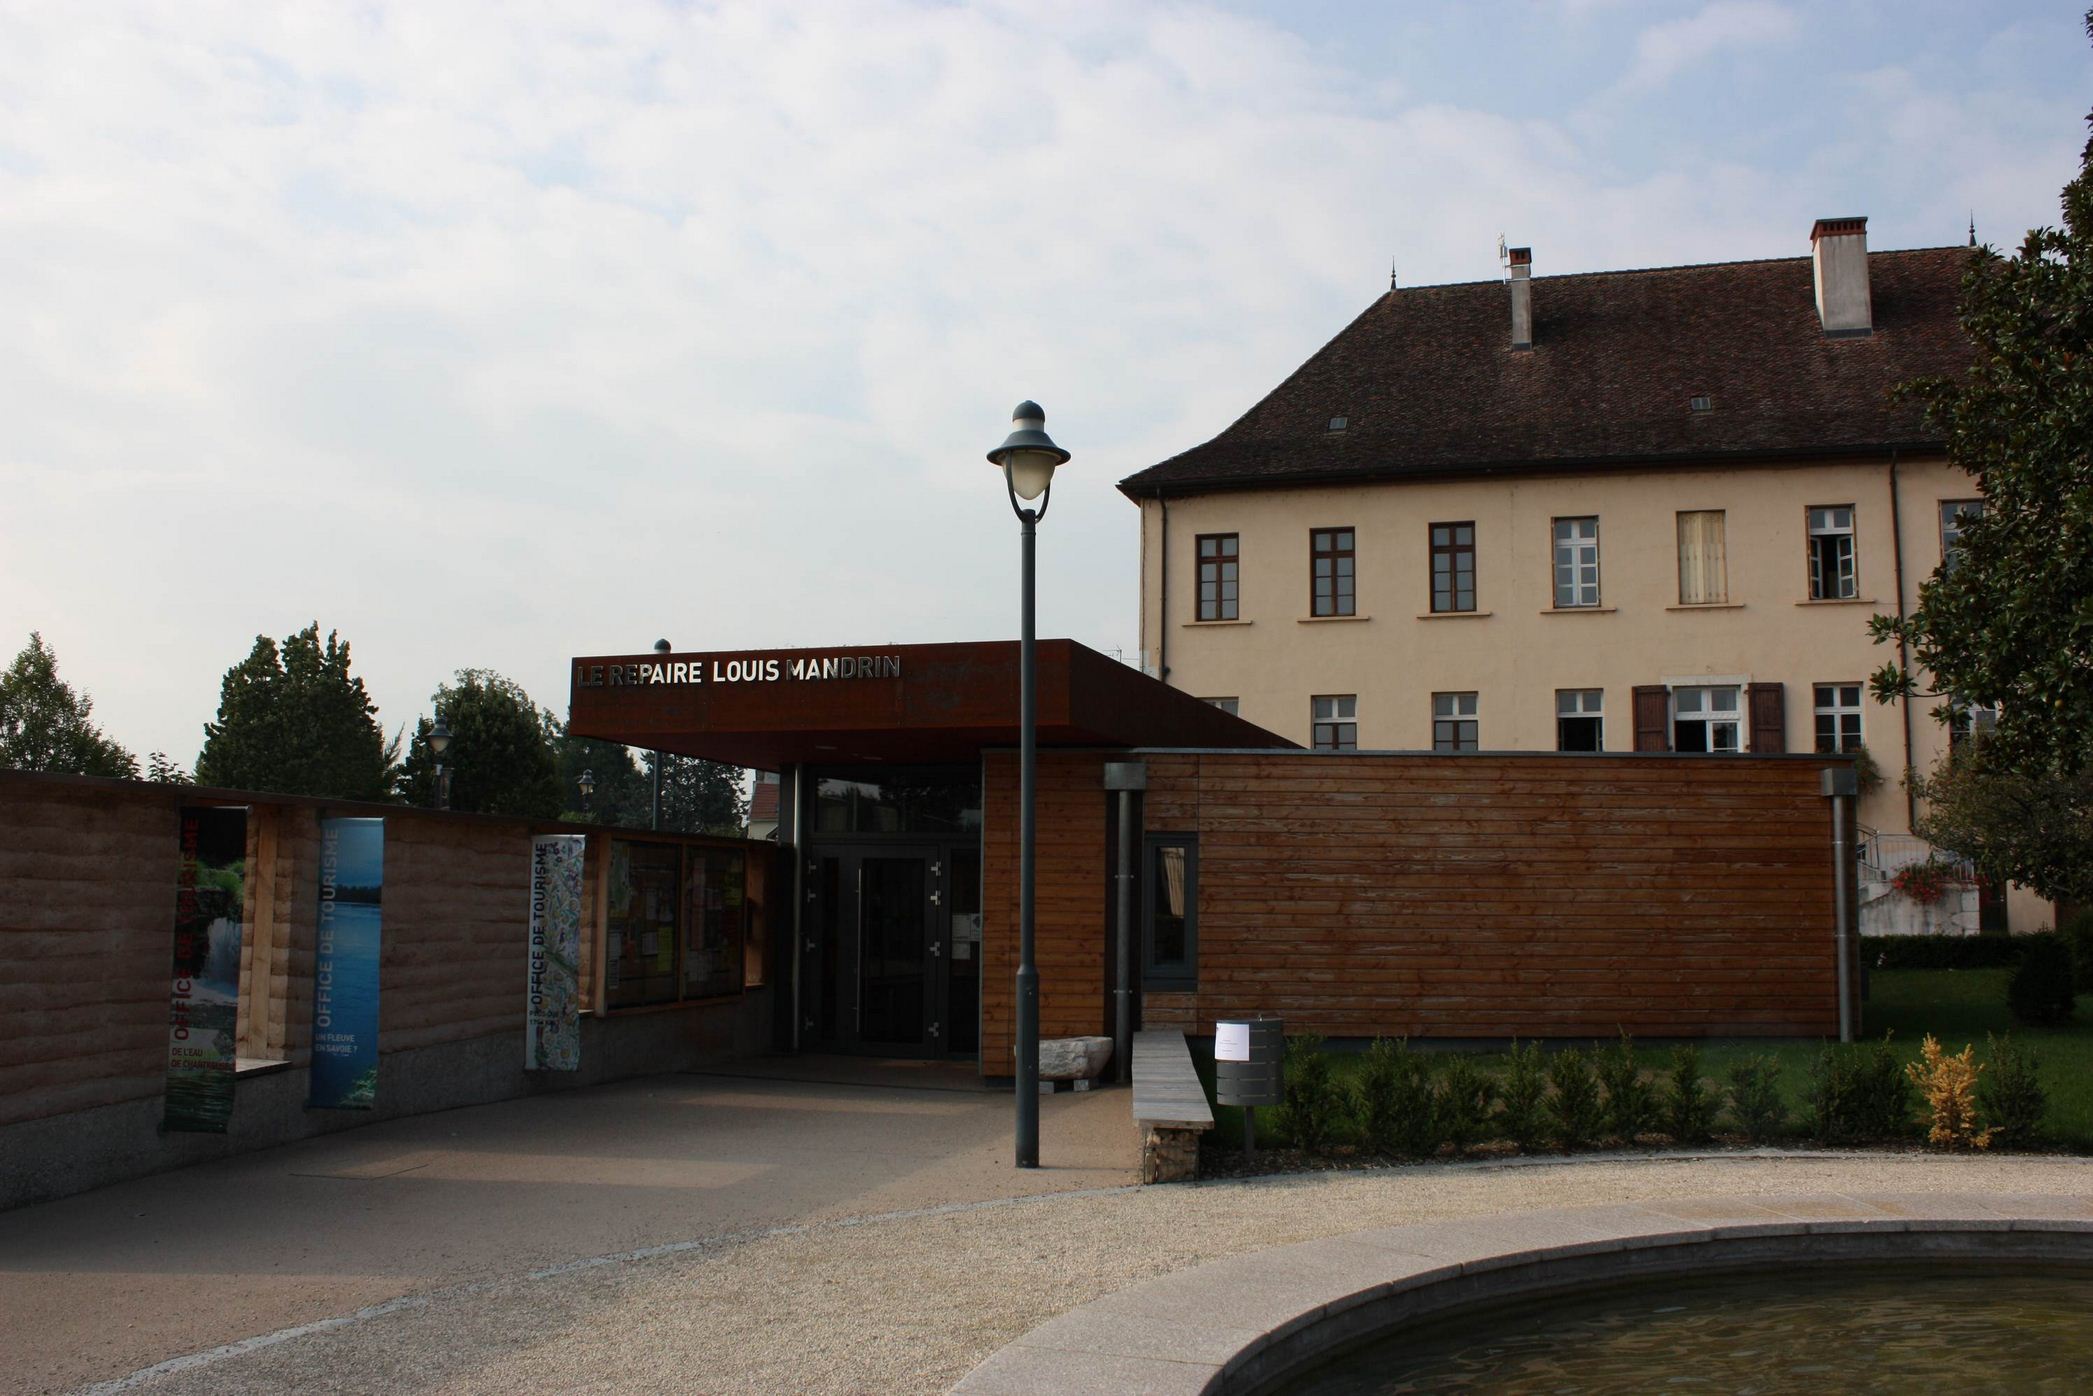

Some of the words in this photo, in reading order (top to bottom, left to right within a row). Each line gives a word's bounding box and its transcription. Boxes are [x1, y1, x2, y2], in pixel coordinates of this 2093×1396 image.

[577, 665, 604, 687] LE
[608, 662, 702, 686] REPAIRE
[713, 660, 780, 682] LOUIS
[786, 655, 900, 681] MANDRIN
[320, 828, 339, 924] TOURISME
[533, 842, 549, 921] TOURISME
[319, 930, 334, 954] DE
[533, 924, 545, 946] DE
[174, 969, 193, 1041] OFFICE
[317, 962, 333, 1028] OFFICE
[530, 951, 545, 1007] OFFICE
